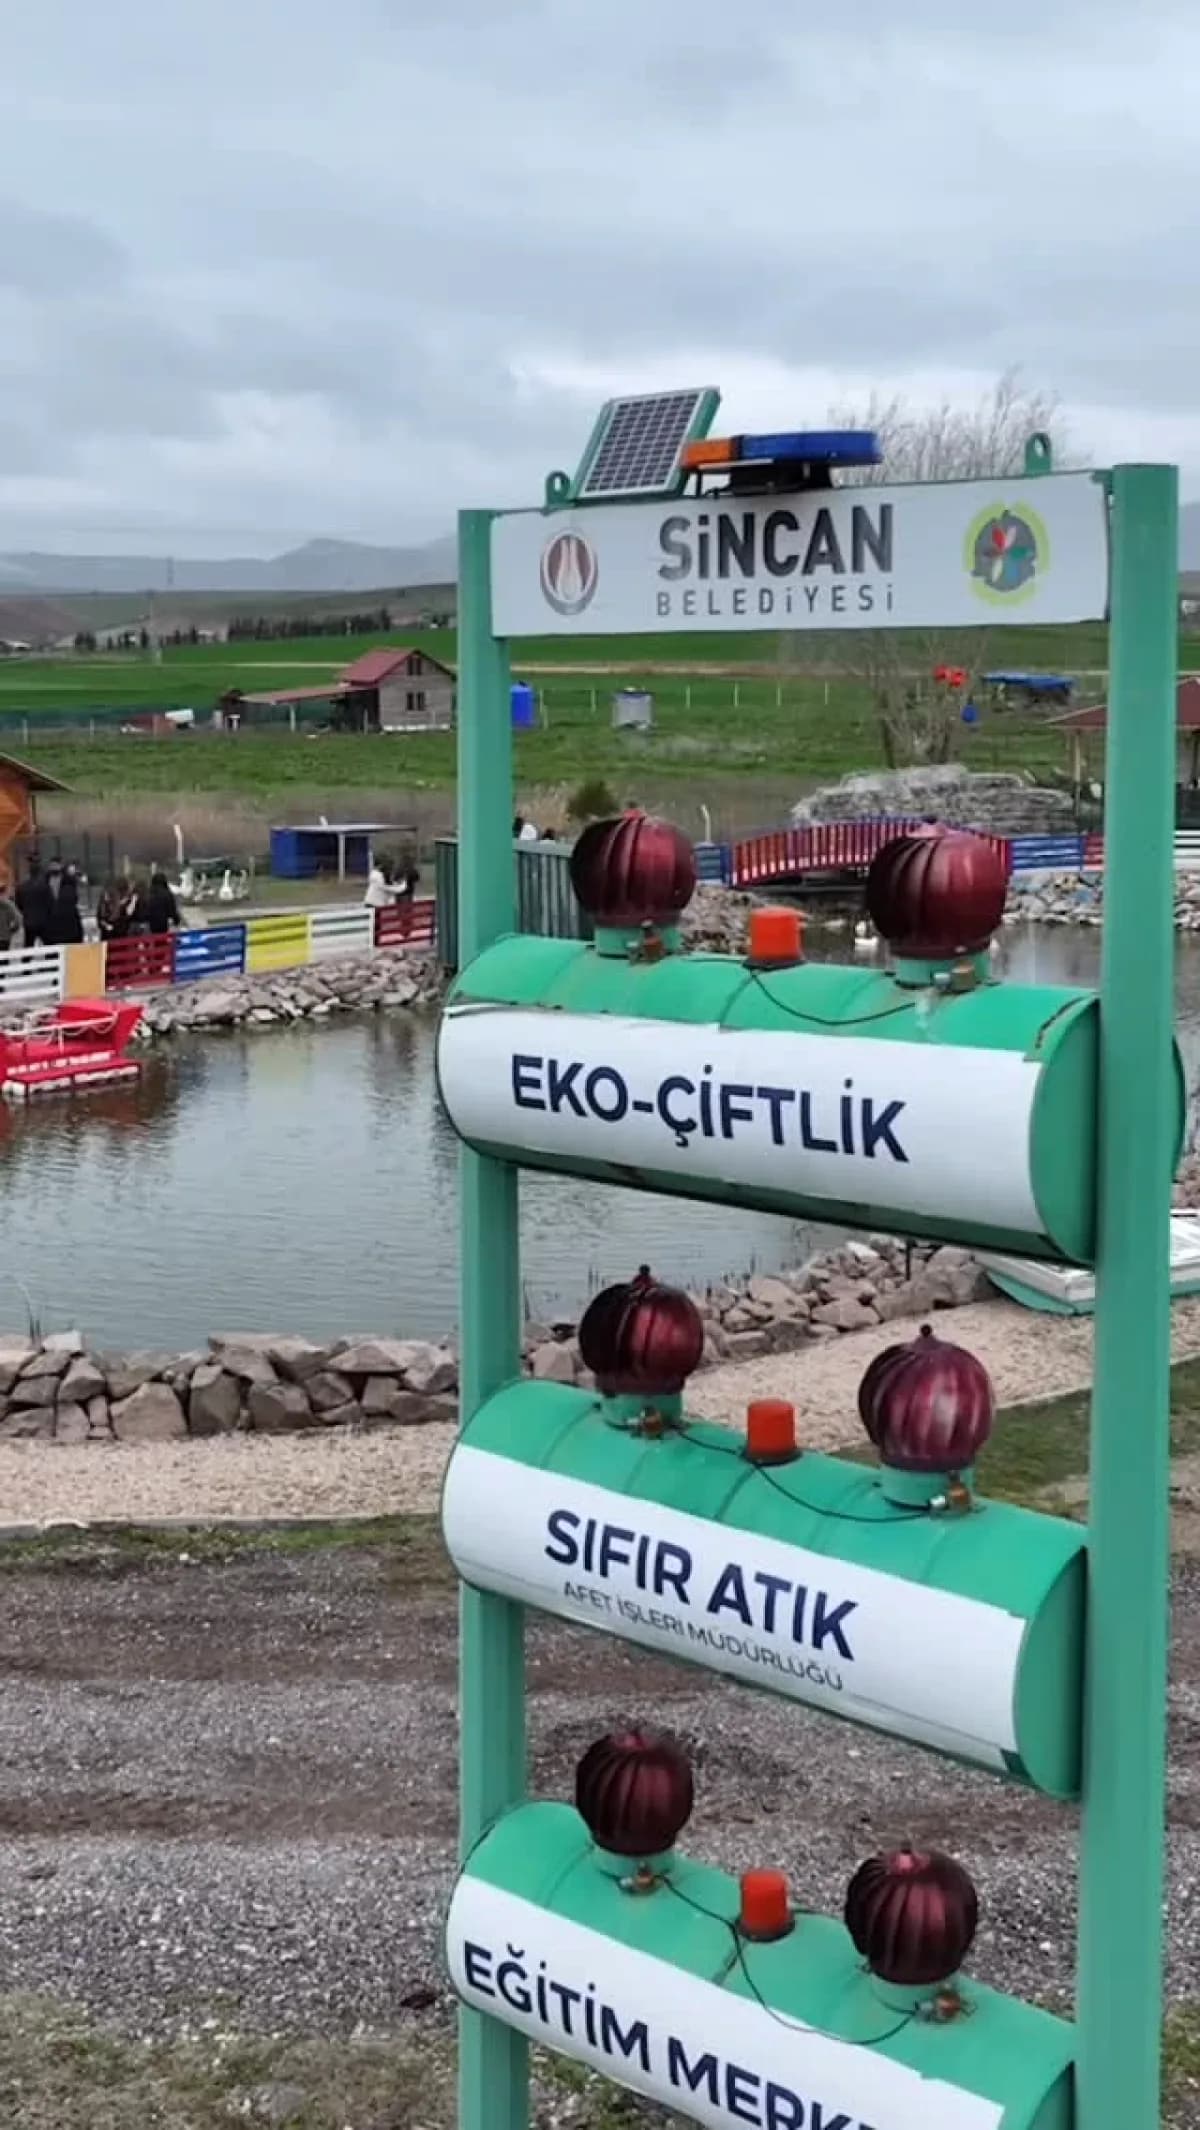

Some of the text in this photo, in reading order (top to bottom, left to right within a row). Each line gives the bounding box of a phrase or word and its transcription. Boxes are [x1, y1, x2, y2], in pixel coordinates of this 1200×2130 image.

[511, 1053, 910, 1164] EKO-ÇİFTLİK
[545, 1509, 860, 1662] SIFIR ATIK
[564, 1581, 612, 1612] AFET
[464, 1940, 877, 2130] EĞİTİM MERK
